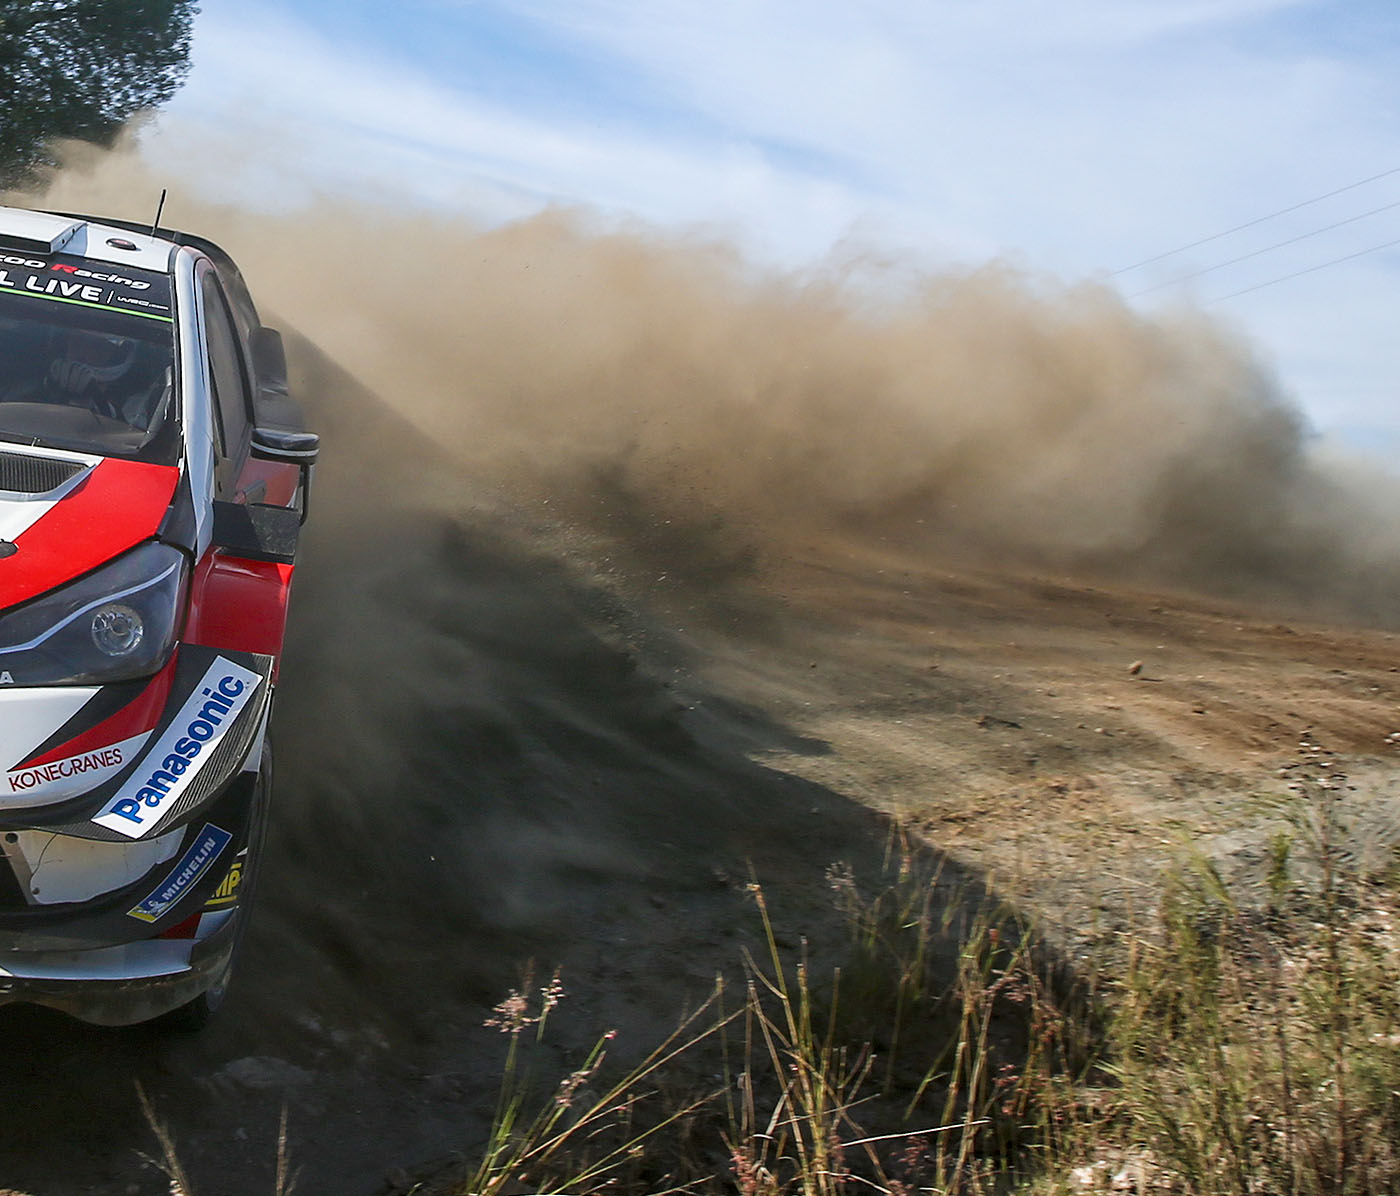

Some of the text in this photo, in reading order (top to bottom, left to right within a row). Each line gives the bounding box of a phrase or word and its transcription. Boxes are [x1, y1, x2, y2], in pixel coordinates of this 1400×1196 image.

[25, 275, 103, 302] LIVE
[51, 263, 151, 290] Racing
[8, 747, 124, 792] KONECRANES
[113, 674, 245, 825] Panasonic
[161, 836, 217, 901] MICHELIN
